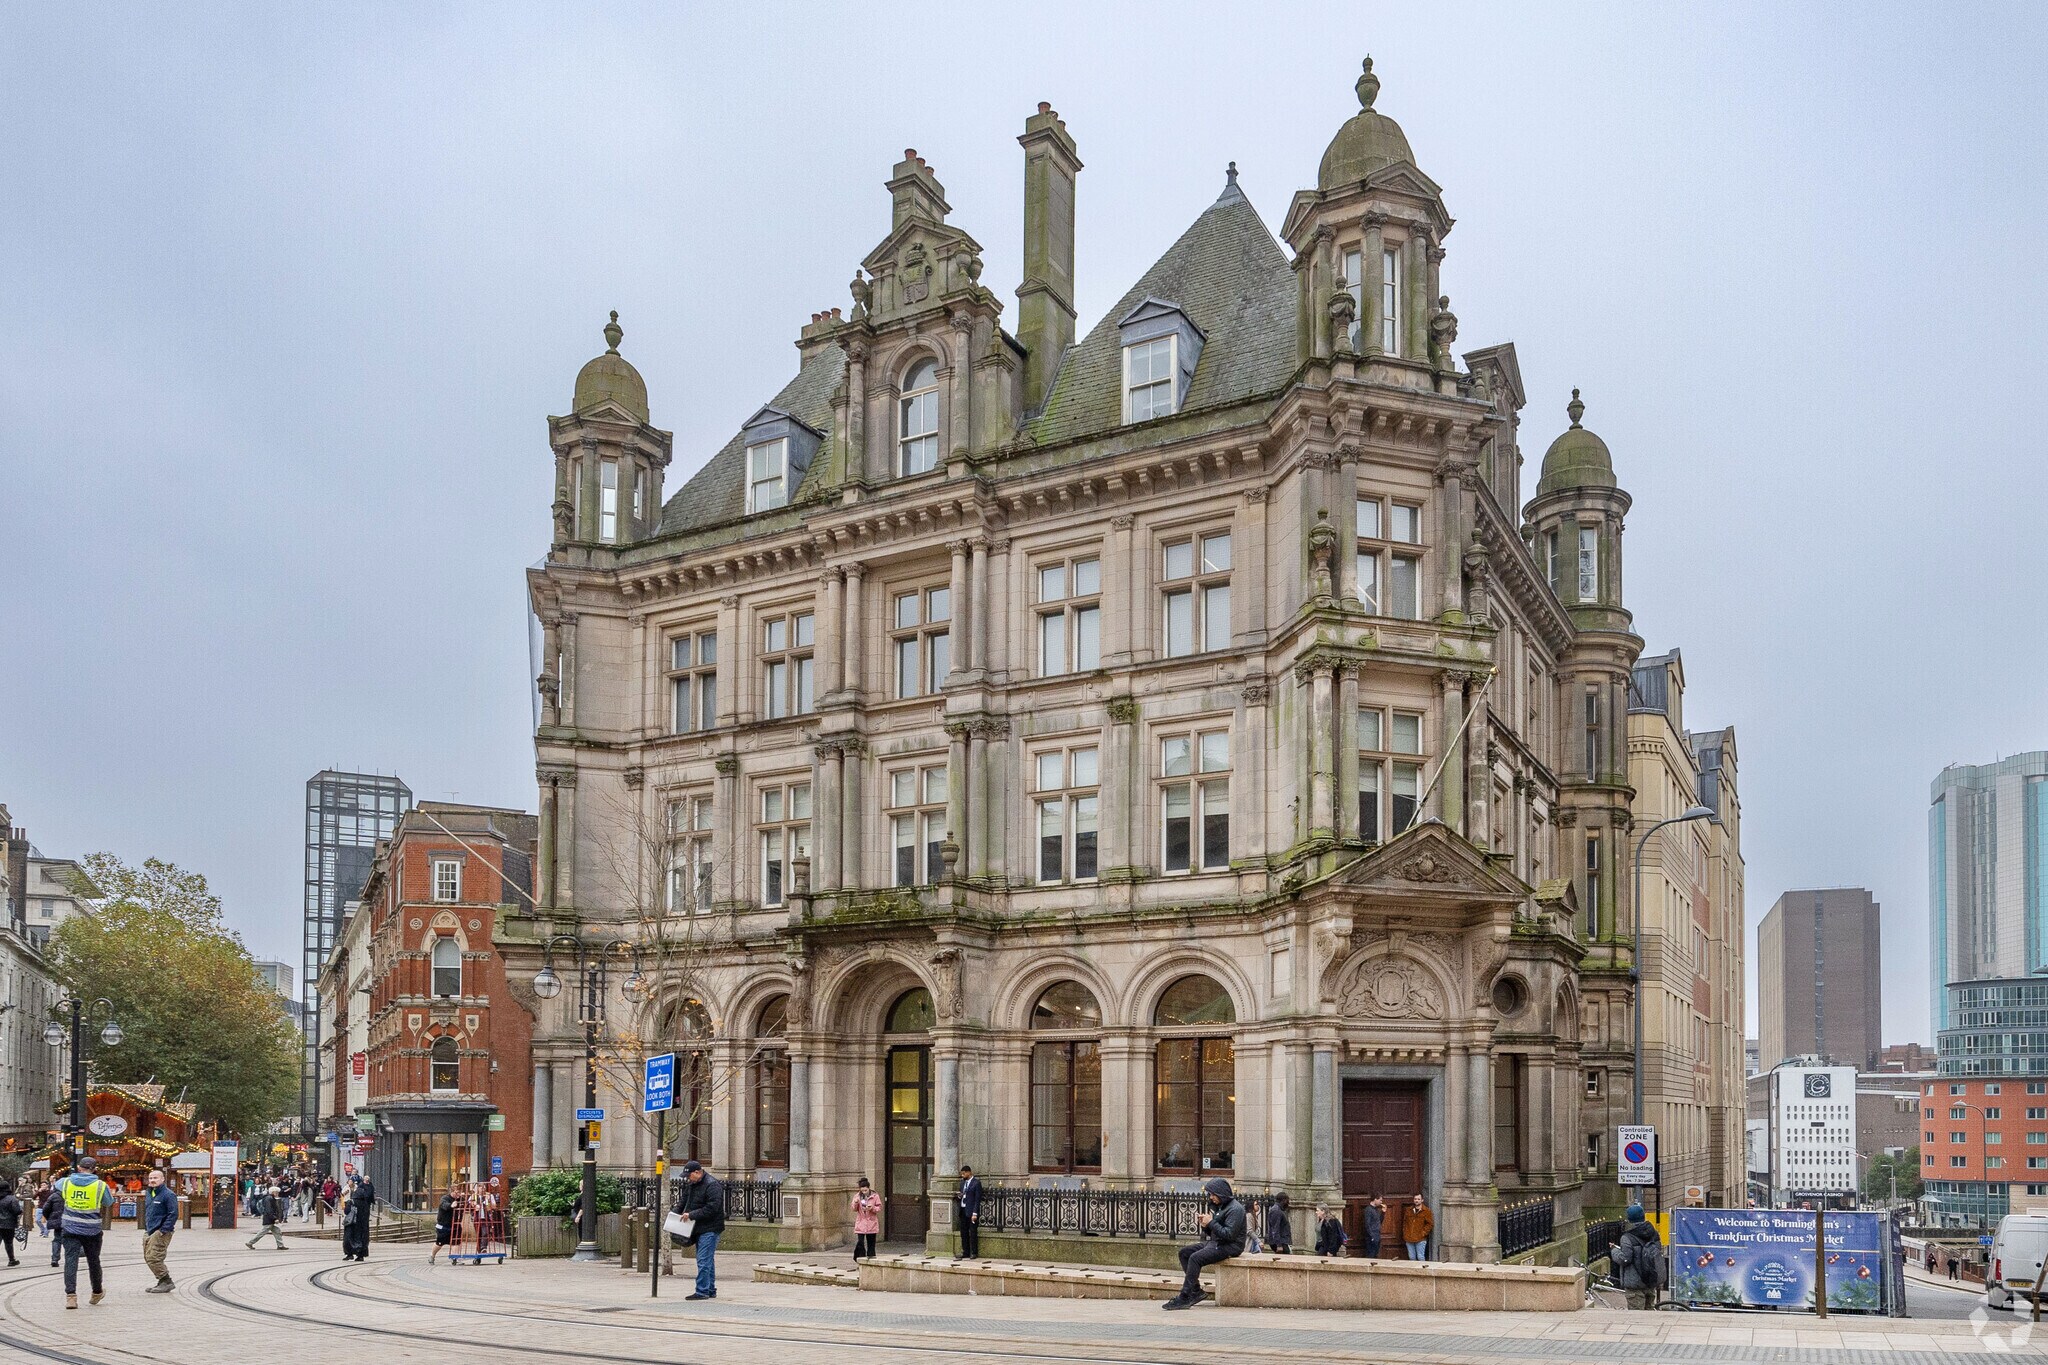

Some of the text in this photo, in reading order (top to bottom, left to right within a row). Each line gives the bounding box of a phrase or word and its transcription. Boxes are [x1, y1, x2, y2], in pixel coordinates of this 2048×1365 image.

[650, 1058, 670, 1068] TRAMWAY
[647, 1091, 671, 1101] LOOK BOTH
[652, 1100, 665, 1108] WAYS
[71, 1191, 90, 1200] JRL
[1714, 1217, 1758, 1228] Welcome
[1760, 1219, 1770, 1228] to
[1707, 1231, 1844, 1245] Frankfurt Christmas Mrket
